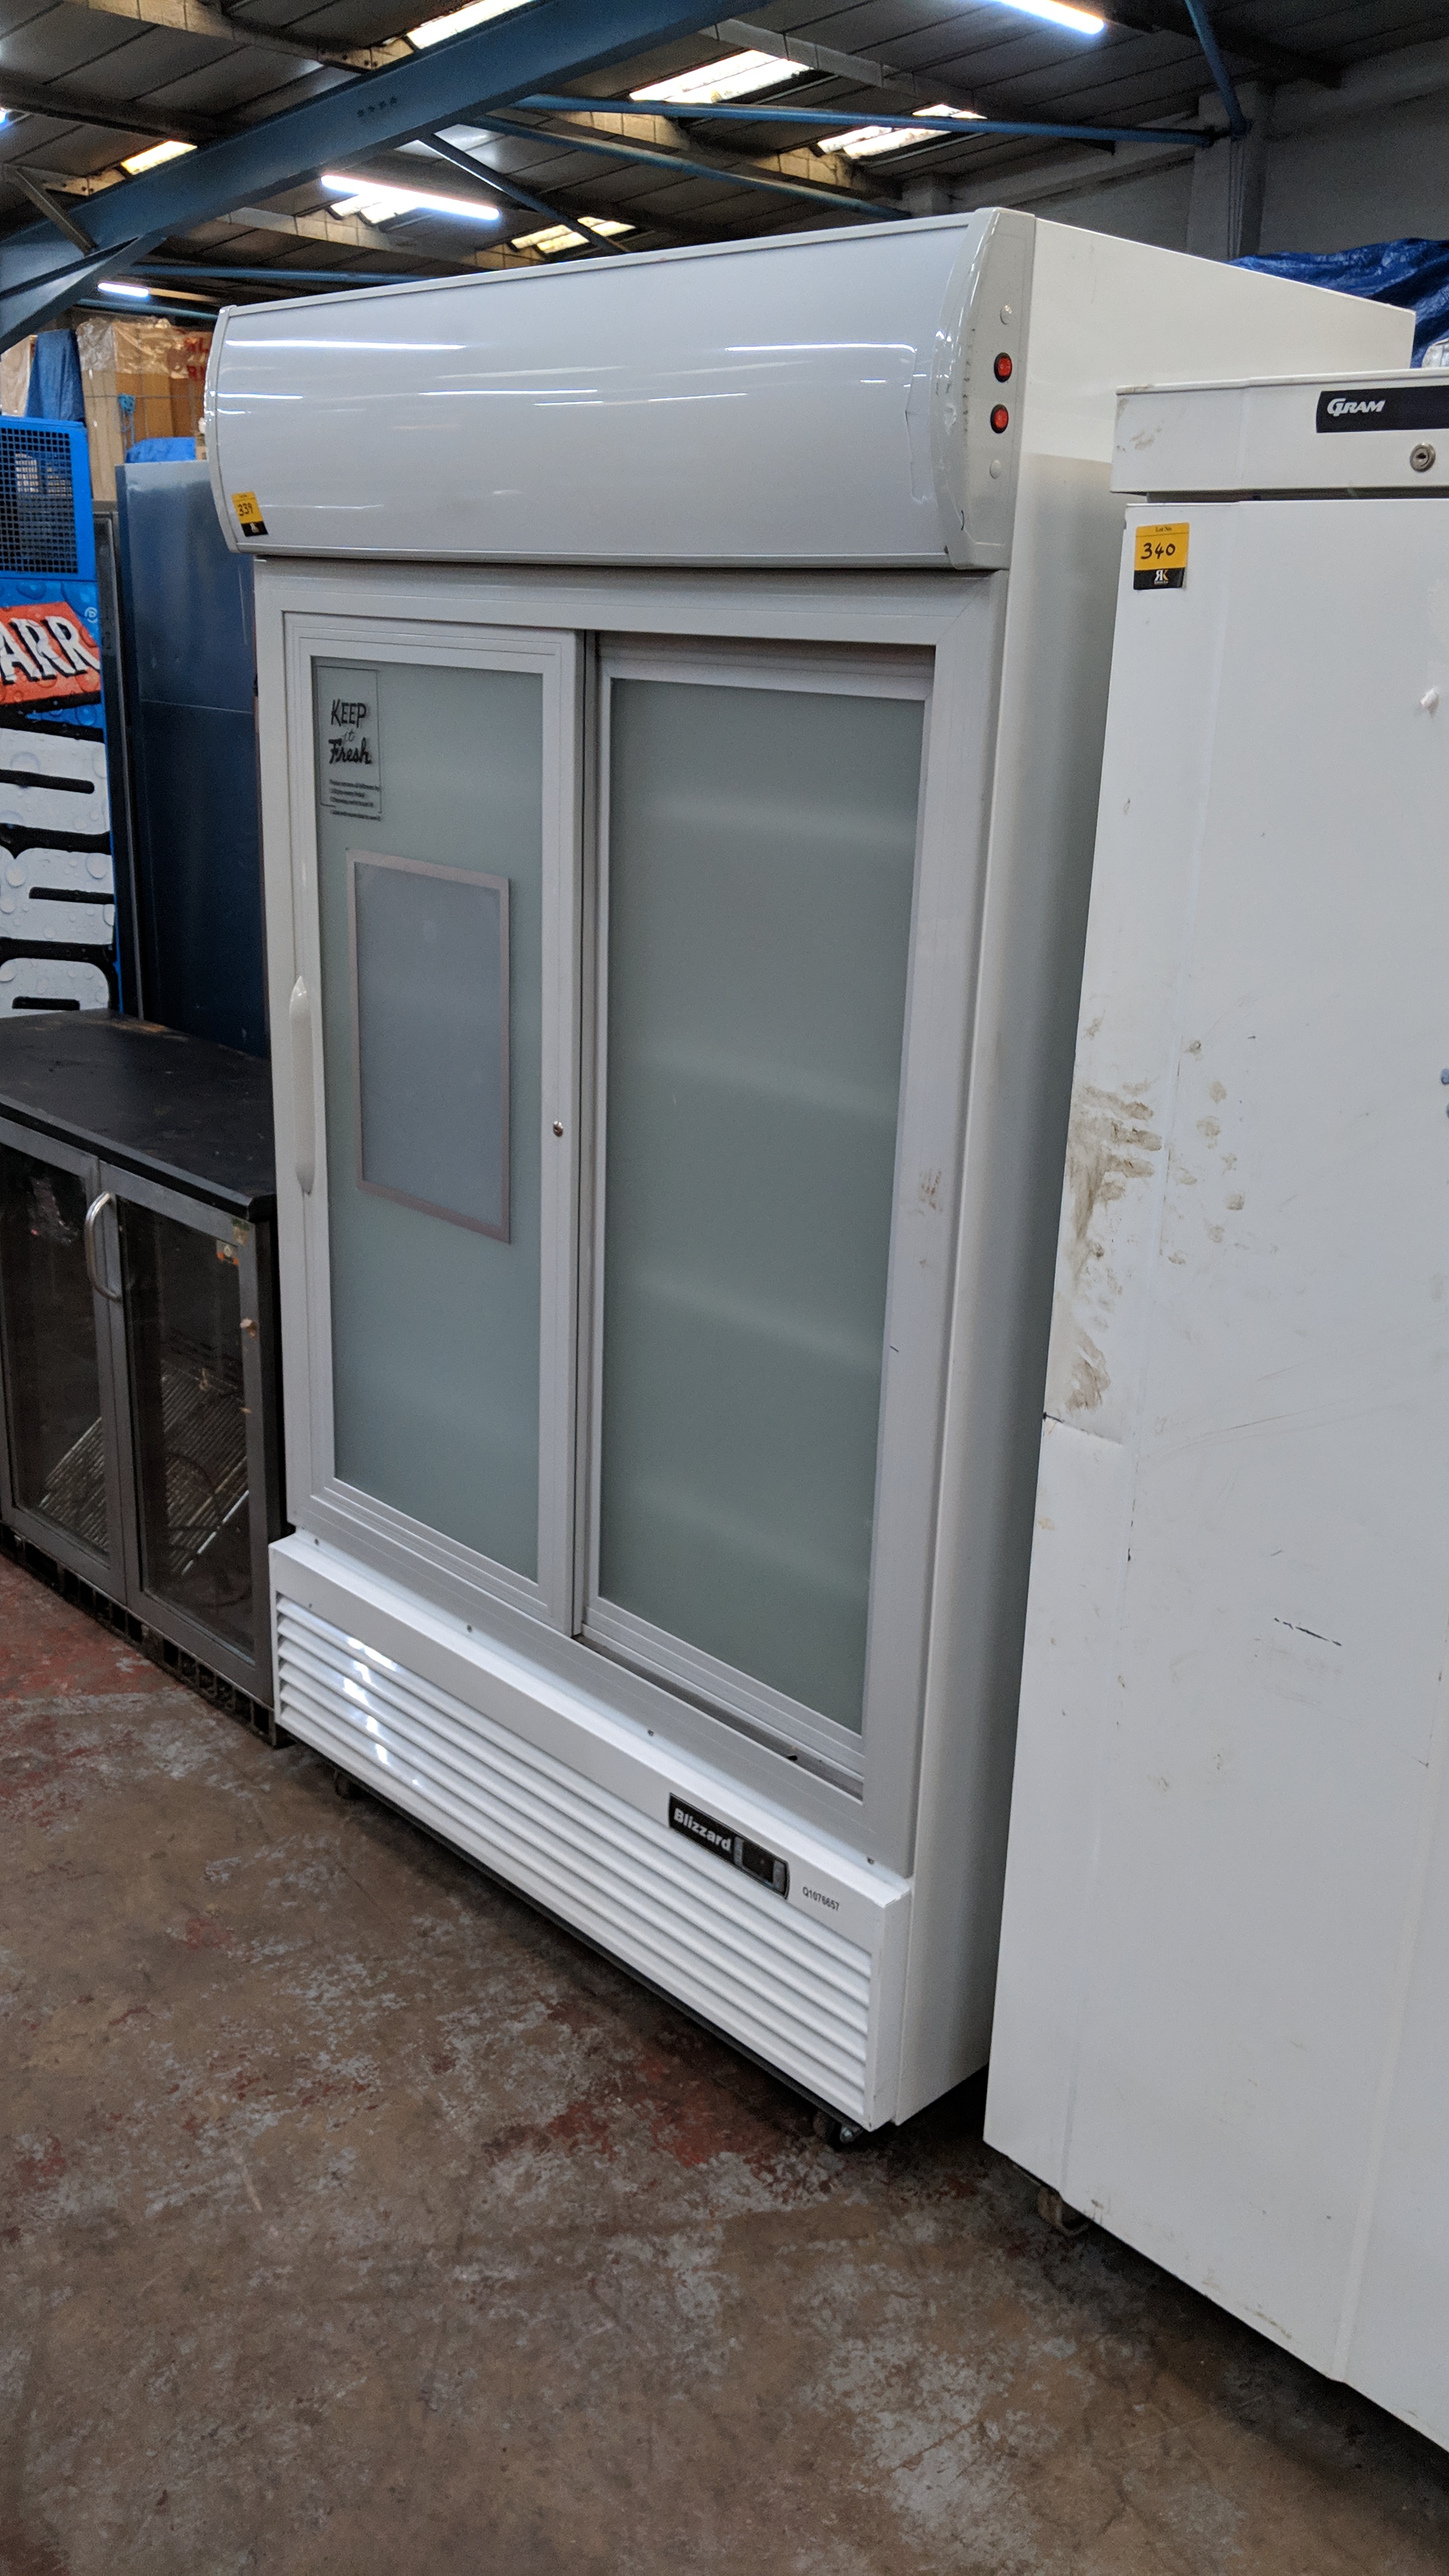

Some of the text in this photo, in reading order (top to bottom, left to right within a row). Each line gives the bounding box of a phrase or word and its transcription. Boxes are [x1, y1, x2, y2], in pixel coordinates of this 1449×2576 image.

[1327, 398, 1386, 417] GRAM
[1140, 542, 1176, 559] 340
[331, 698, 367, 728] KEEP
[329, 737, 372, 764] Fresh
[674, 1808, 732, 1851] Blizzard
